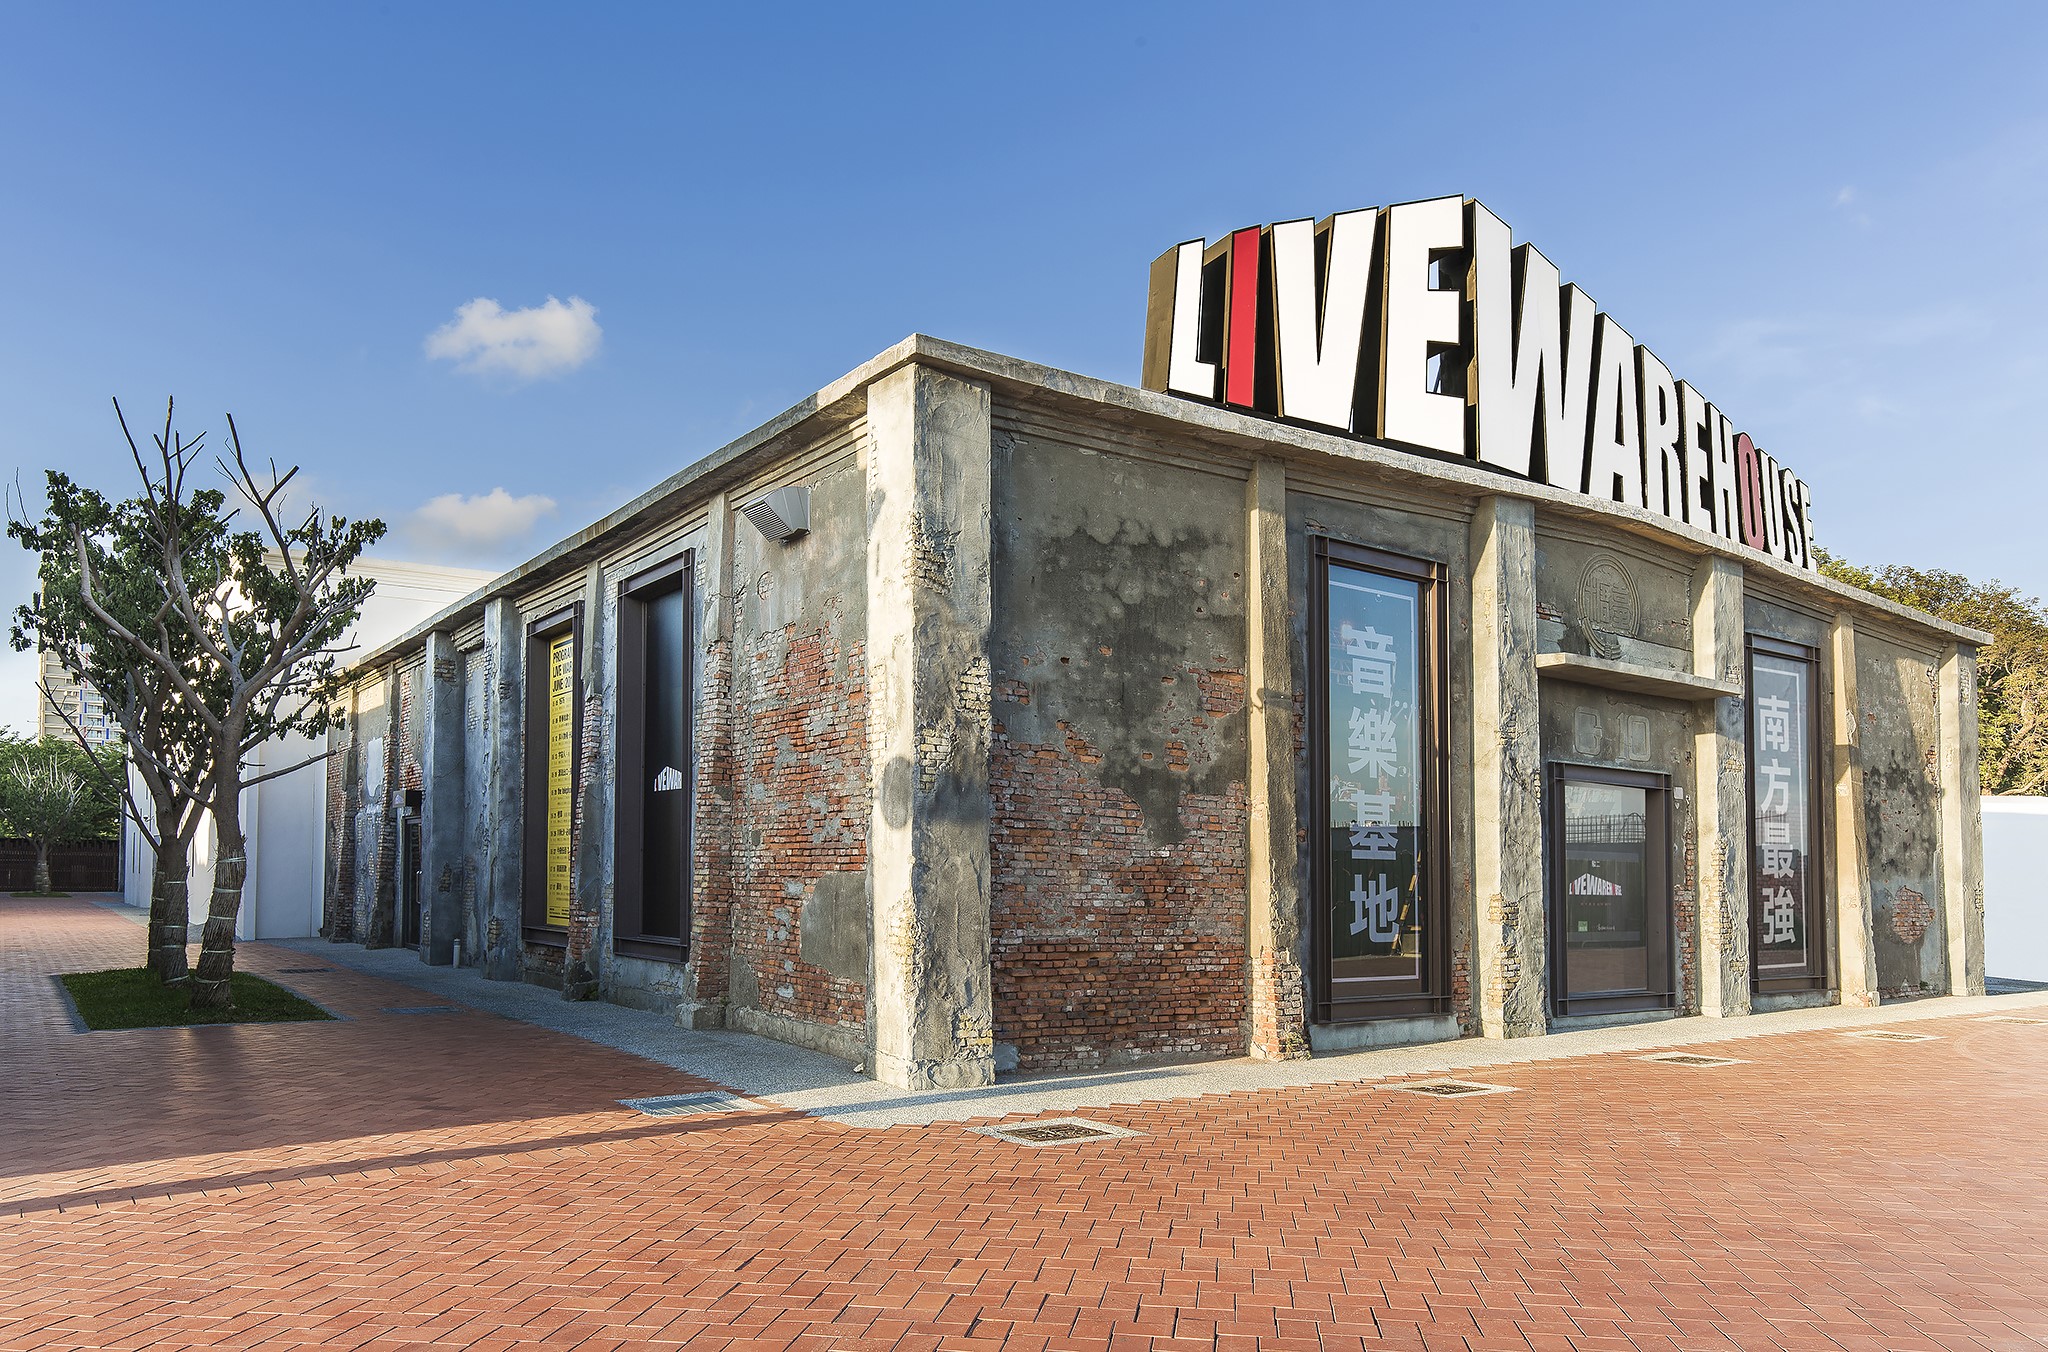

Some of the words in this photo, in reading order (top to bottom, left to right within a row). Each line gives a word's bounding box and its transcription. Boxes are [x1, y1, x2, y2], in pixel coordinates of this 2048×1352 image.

[1168, 194, 1465, 456] LIVE
[1473, 198, 1818, 574] WAREHOUSE
[552, 678, 563, 692] JUNE
[1345, 626, 1400, 944] 音樂基地
[1757, 694, 1797, 945] 南方最強
